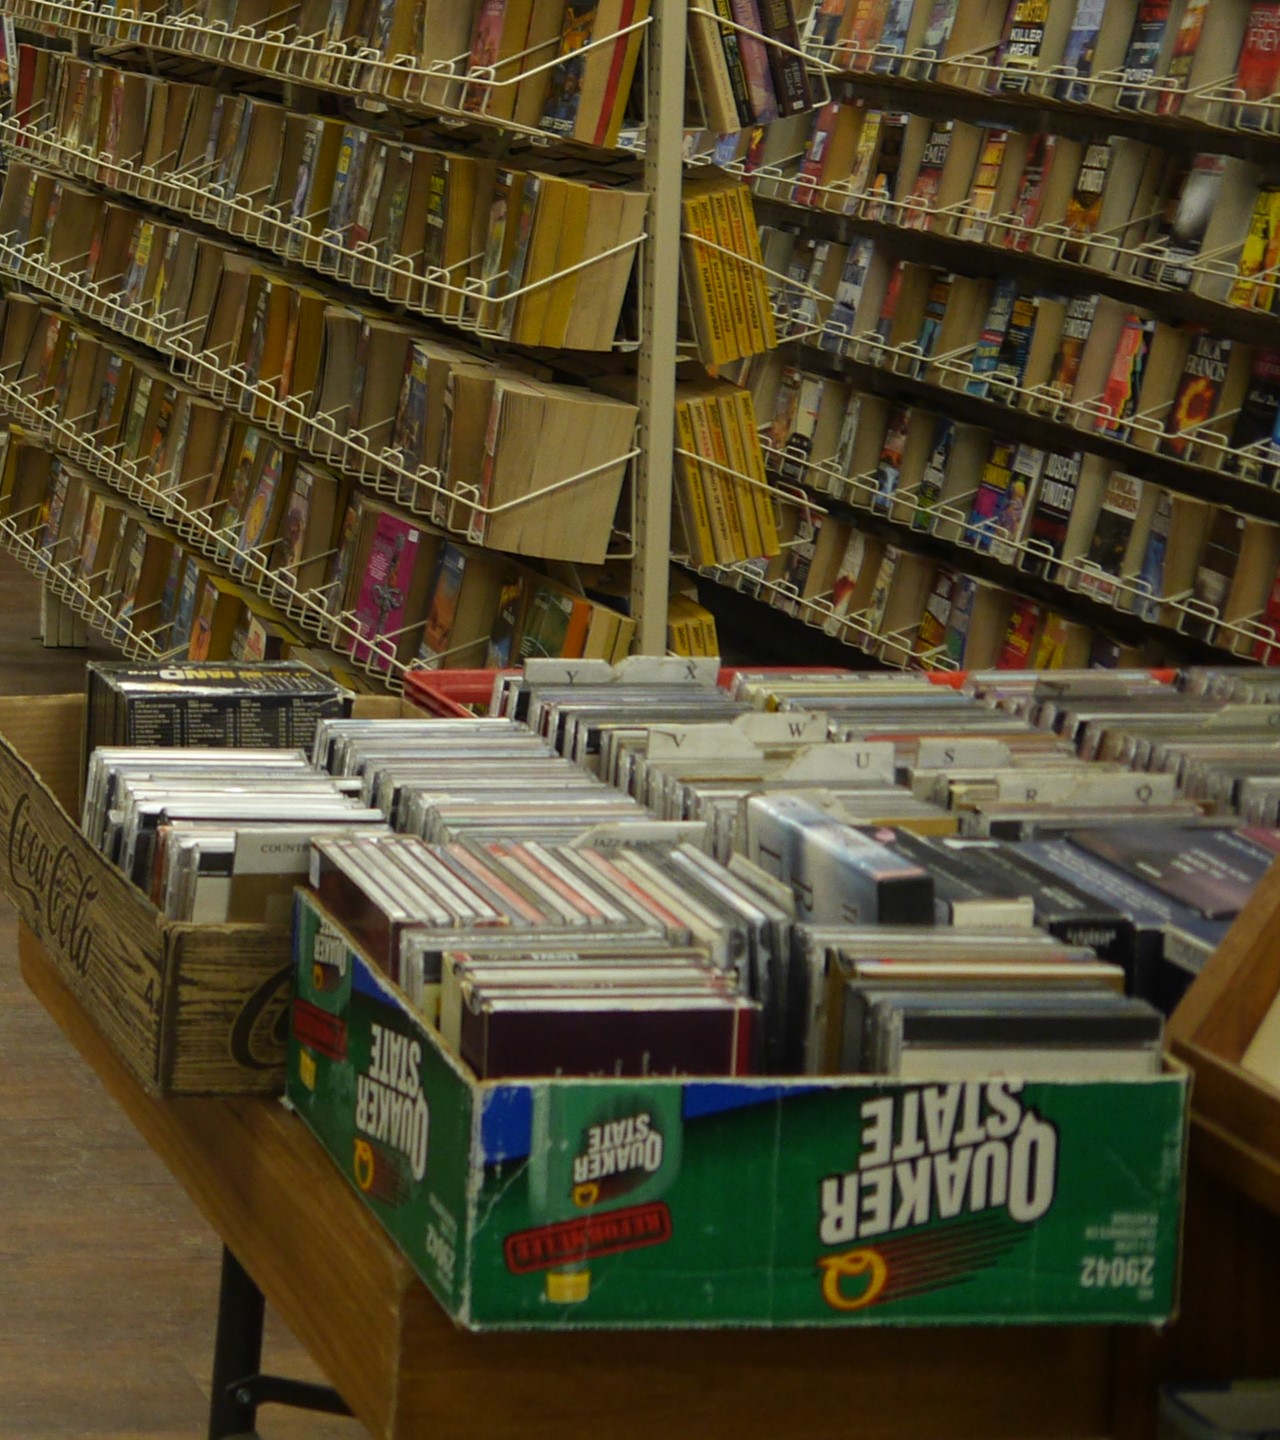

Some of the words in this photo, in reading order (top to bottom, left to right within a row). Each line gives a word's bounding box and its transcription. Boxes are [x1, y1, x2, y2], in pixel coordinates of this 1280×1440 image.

[1010, 27, 1043, 43] KILLER
[1009, 44, 1037, 57] HEAT
[1046, 451, 1082, 487] JOSEPH
[1040, 478, 1075, 512] FINDER
[566, 670, 579, 685] Y
[685, 665, 696, 680] X
[788, 722, 805, 738] W
[855, 752, 871, 769] U
[943, 748, 955, 763] S
[1026, 788, 1038, 802] R
[1135, 784, 1152, 803] Q
[260, 843, 310, 854] COUNTR
[7, 792, 99, 977] Coca-Cola
[369, 1023, 422, 1098] STATE
[355, 1073, 430, 1182] QUAKER
[588, 1112, 652, 1156] STATE
[860, 1081, 1026, 1170] STATE
[573, 1130, 664, 1185] QUAKER
[819, 1111, 1061, 1246] QUAKER
[1081, 1255, 1155, 1289] 29042
